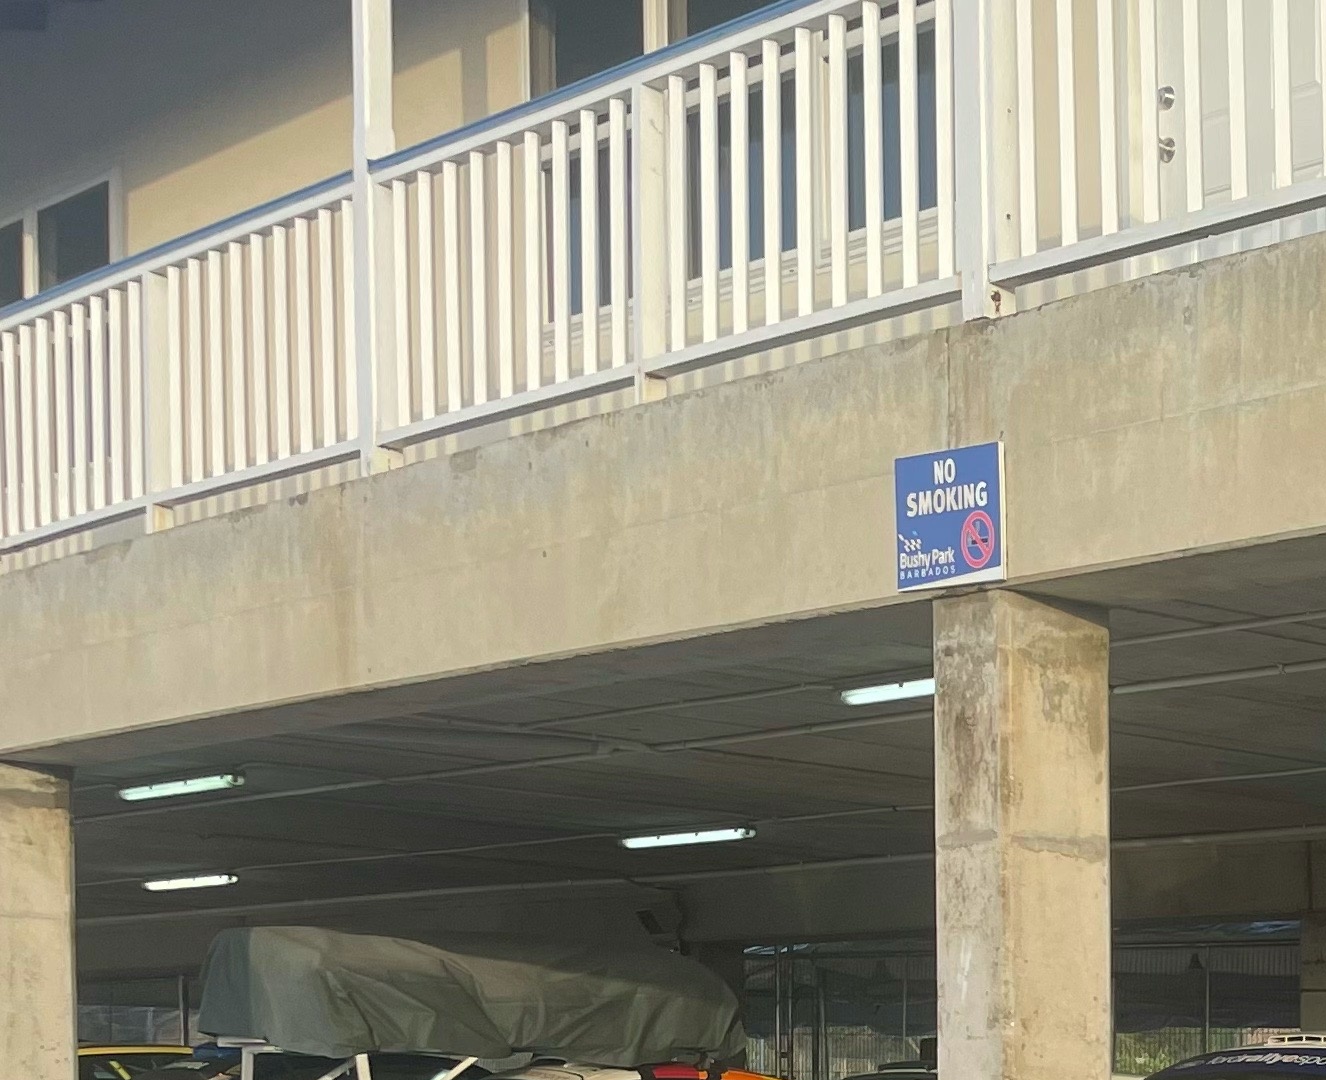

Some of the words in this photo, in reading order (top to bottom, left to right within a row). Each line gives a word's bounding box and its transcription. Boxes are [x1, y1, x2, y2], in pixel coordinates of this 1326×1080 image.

[933, 458, 956, 485] NO
[907, 481, 988, 517] SMOKING
[900, 552, 931, 571] Bushy
[932, 546, 955, 566] Park
[900, 565, 956, 580] BARBADOS
